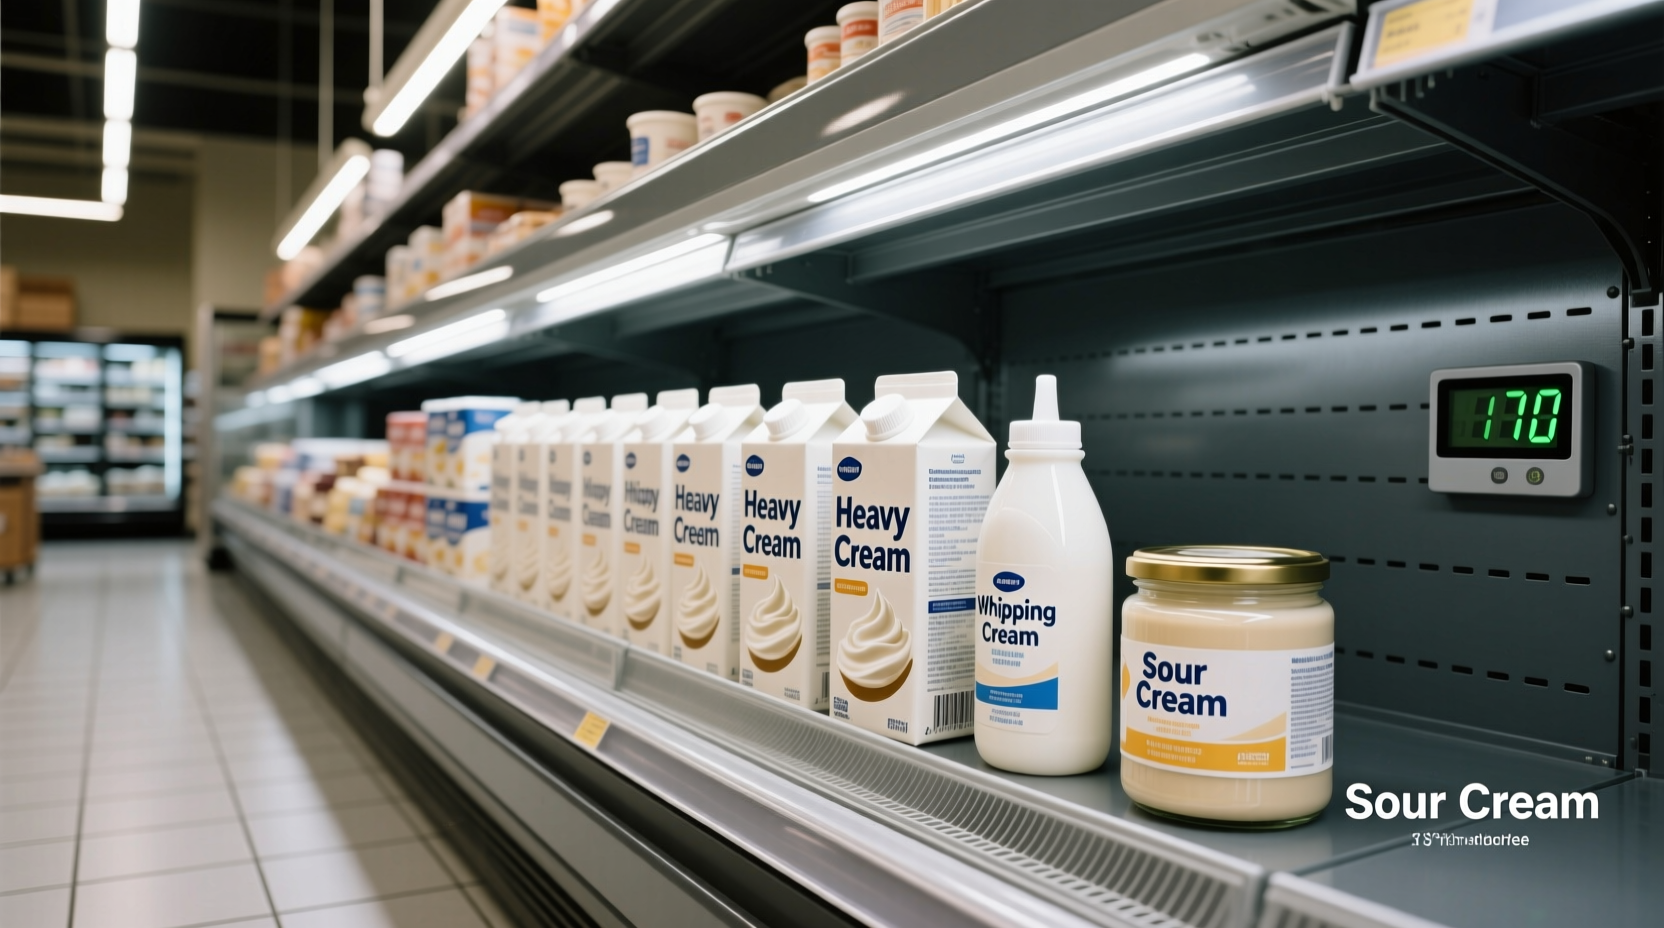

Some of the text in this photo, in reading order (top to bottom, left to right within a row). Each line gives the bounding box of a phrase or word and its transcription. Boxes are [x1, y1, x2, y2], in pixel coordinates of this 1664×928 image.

[1483, 388, 1562, 444] 170
[675, 484, 720, 521] Heavy
[744, 489, 802, 530] Heavy
[836, 496, 911, 541] Heavy
[743, 524, 802, 560] Cream
[834, 534, 911, 573] Cream
[977, 595, 1056, 627] Whipping
[982, 621, 1039, 646] Cream
[1142, 651, 1208, 685] Sour
[1136, 680, 1227, 717] Cream
